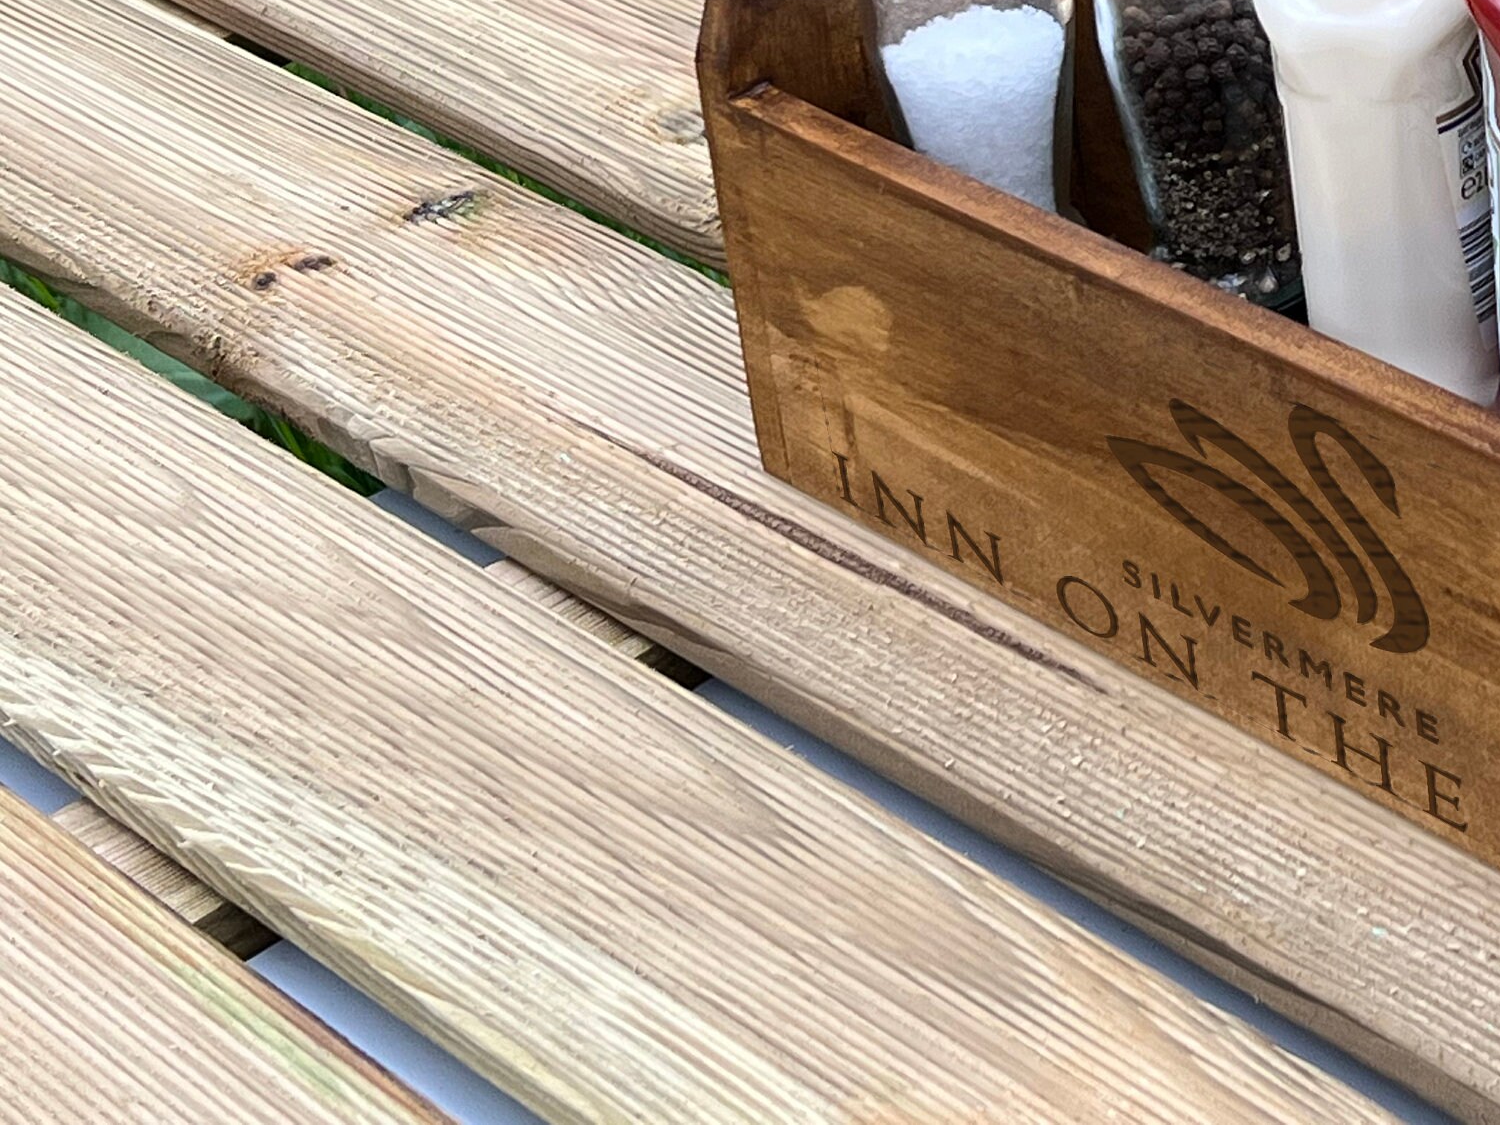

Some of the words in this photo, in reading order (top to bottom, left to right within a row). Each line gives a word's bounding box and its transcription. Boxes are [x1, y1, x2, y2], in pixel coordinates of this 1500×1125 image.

[832, 451, 1005, 586] INN
[1056, 575, 1201, 691] ON
[1251, 671, 1468, 832] THE
[1122, 560, 1440, 744] SILVERMERE
